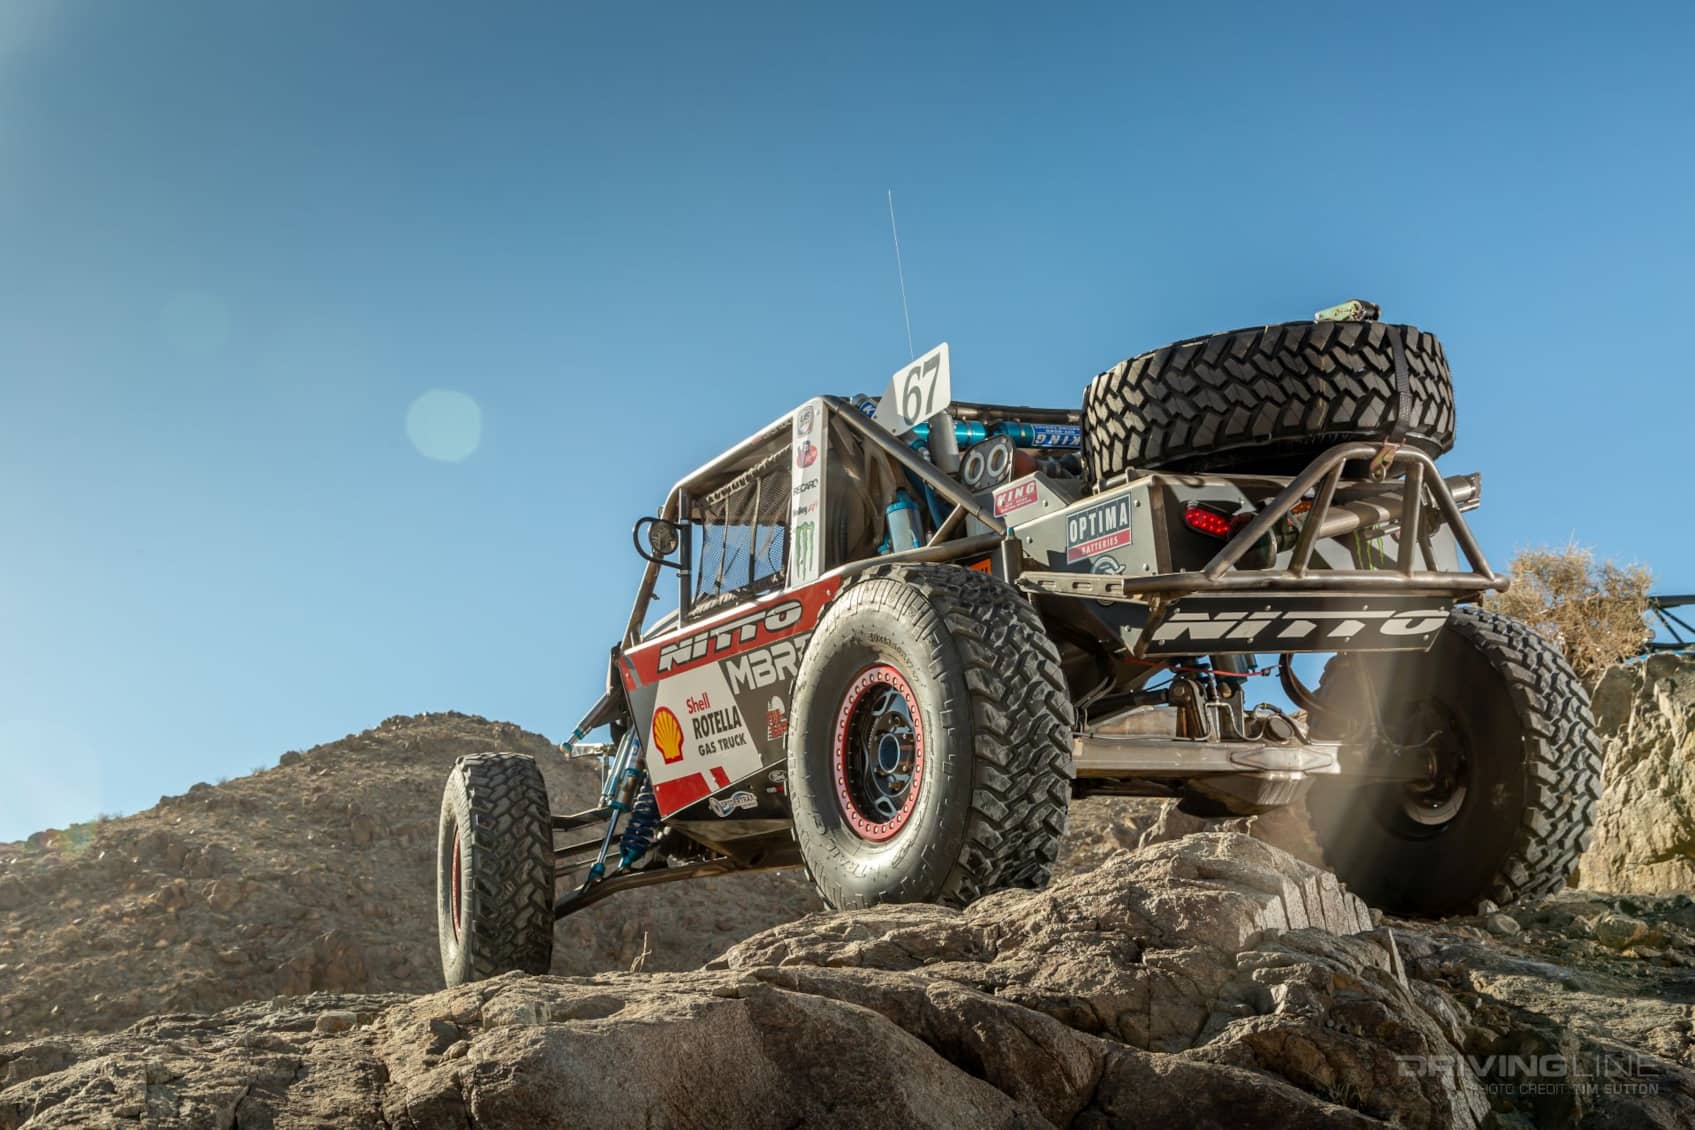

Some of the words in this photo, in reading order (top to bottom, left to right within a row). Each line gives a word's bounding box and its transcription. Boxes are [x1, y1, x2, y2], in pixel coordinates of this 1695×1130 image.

[904, 358, 941, 425] 67
[997, 482, 1036, 507] KING
[1068, 502, 1129, 544] OPTIMA
[1081, 535, 1119, 559] BATTERIES
[657, 601, 803, 674] NITTO
[1152, 609, 1450, 641] NITTO
[686, 692, 711, 714] Shell
[693, 706, 742, 739] ROTELLA
[698, 742, 716, 757] GAS
[718, 733, 747, 754] TRUCK
